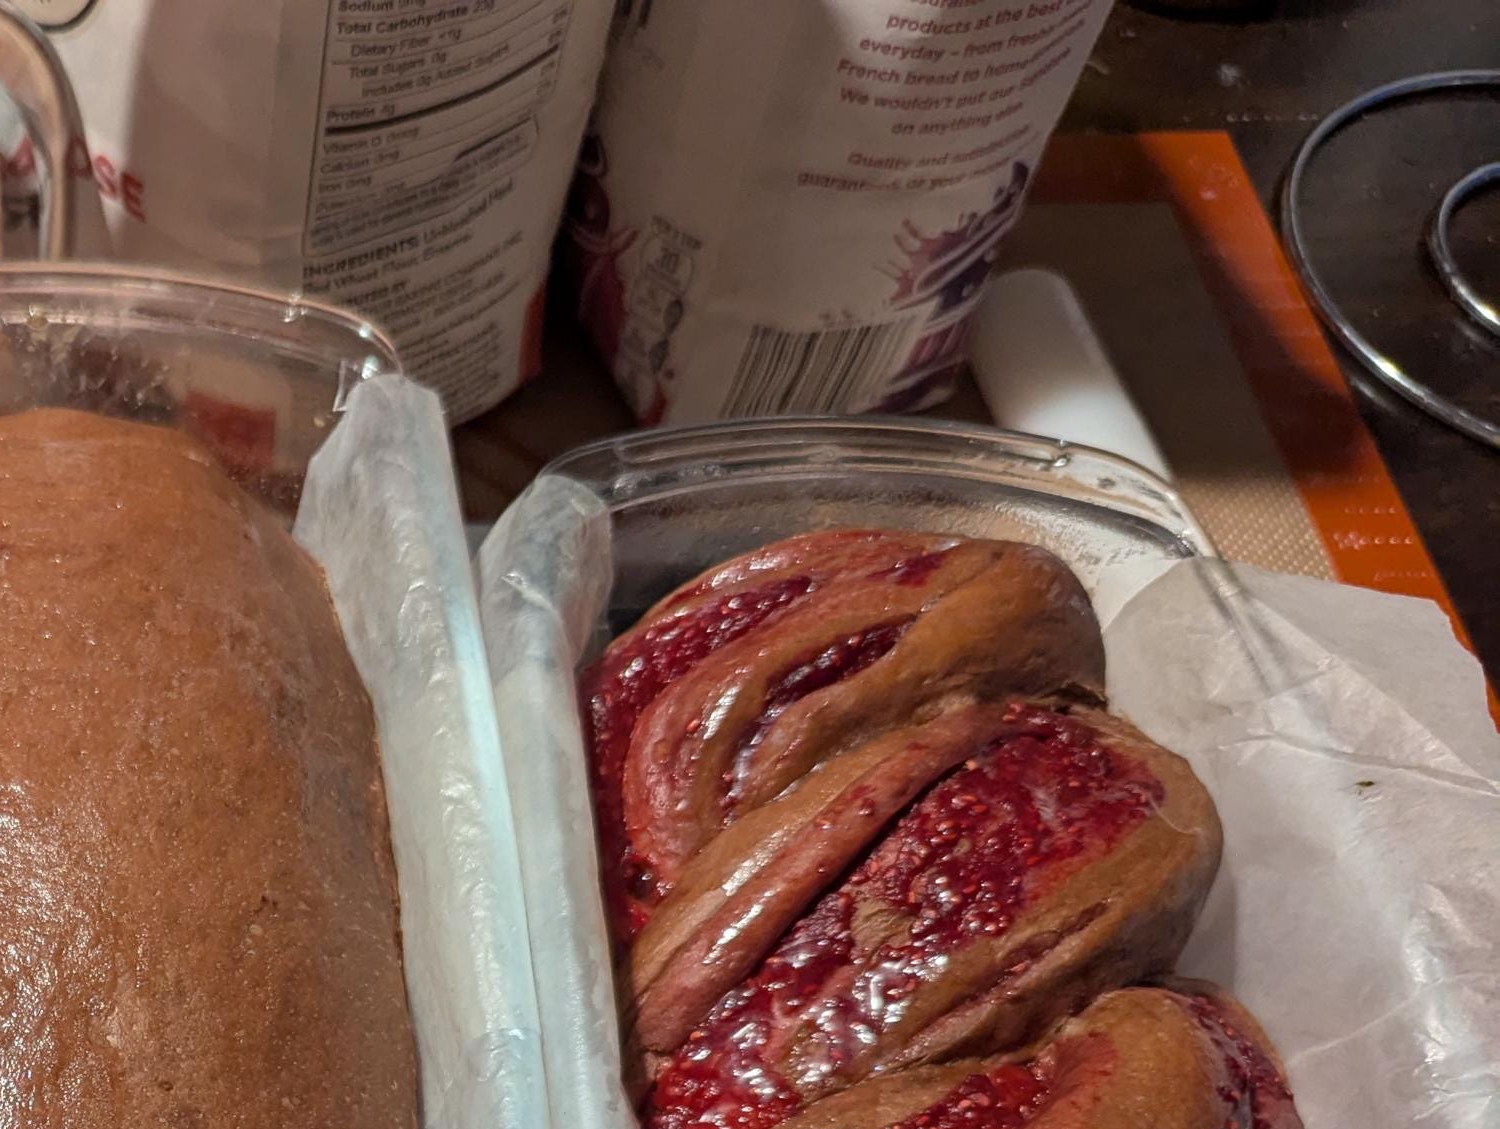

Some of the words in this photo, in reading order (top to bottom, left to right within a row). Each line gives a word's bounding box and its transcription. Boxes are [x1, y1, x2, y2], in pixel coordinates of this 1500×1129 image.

[337, 0, 394, 13] Sodium
[335, 21, 372, 36] Total
[374, 5, 469, 34] Carbohydrate
[886, 12, 971, 35] products
[973, 15, 991, 30] at
[994, 6, 1020, 24] the
[350, 43, 396, 59] Dietary
[398, 35, 431, 50] Fiber
[858, 37, 946, 62] everyday
[962, 40, 1003, 59] from
[349, 65, 379, 80] Total
[381, 58, 426, 77] Sugars
[835, 58, 899, 84] French
[903, 69, 959, 87] bread
[961, 68, 981, 83] to
[839, 87, 869, 105] We
[955, 91, 987, 108] put
[989, 85, 1015, 99] our
[326, 106, 376, 122] Protein
[890, 121, 914, 136] on
[918, 111, 993, 136] anything
[847, 150, 914, 171] Quality
[917, 151, 950, 166] and
